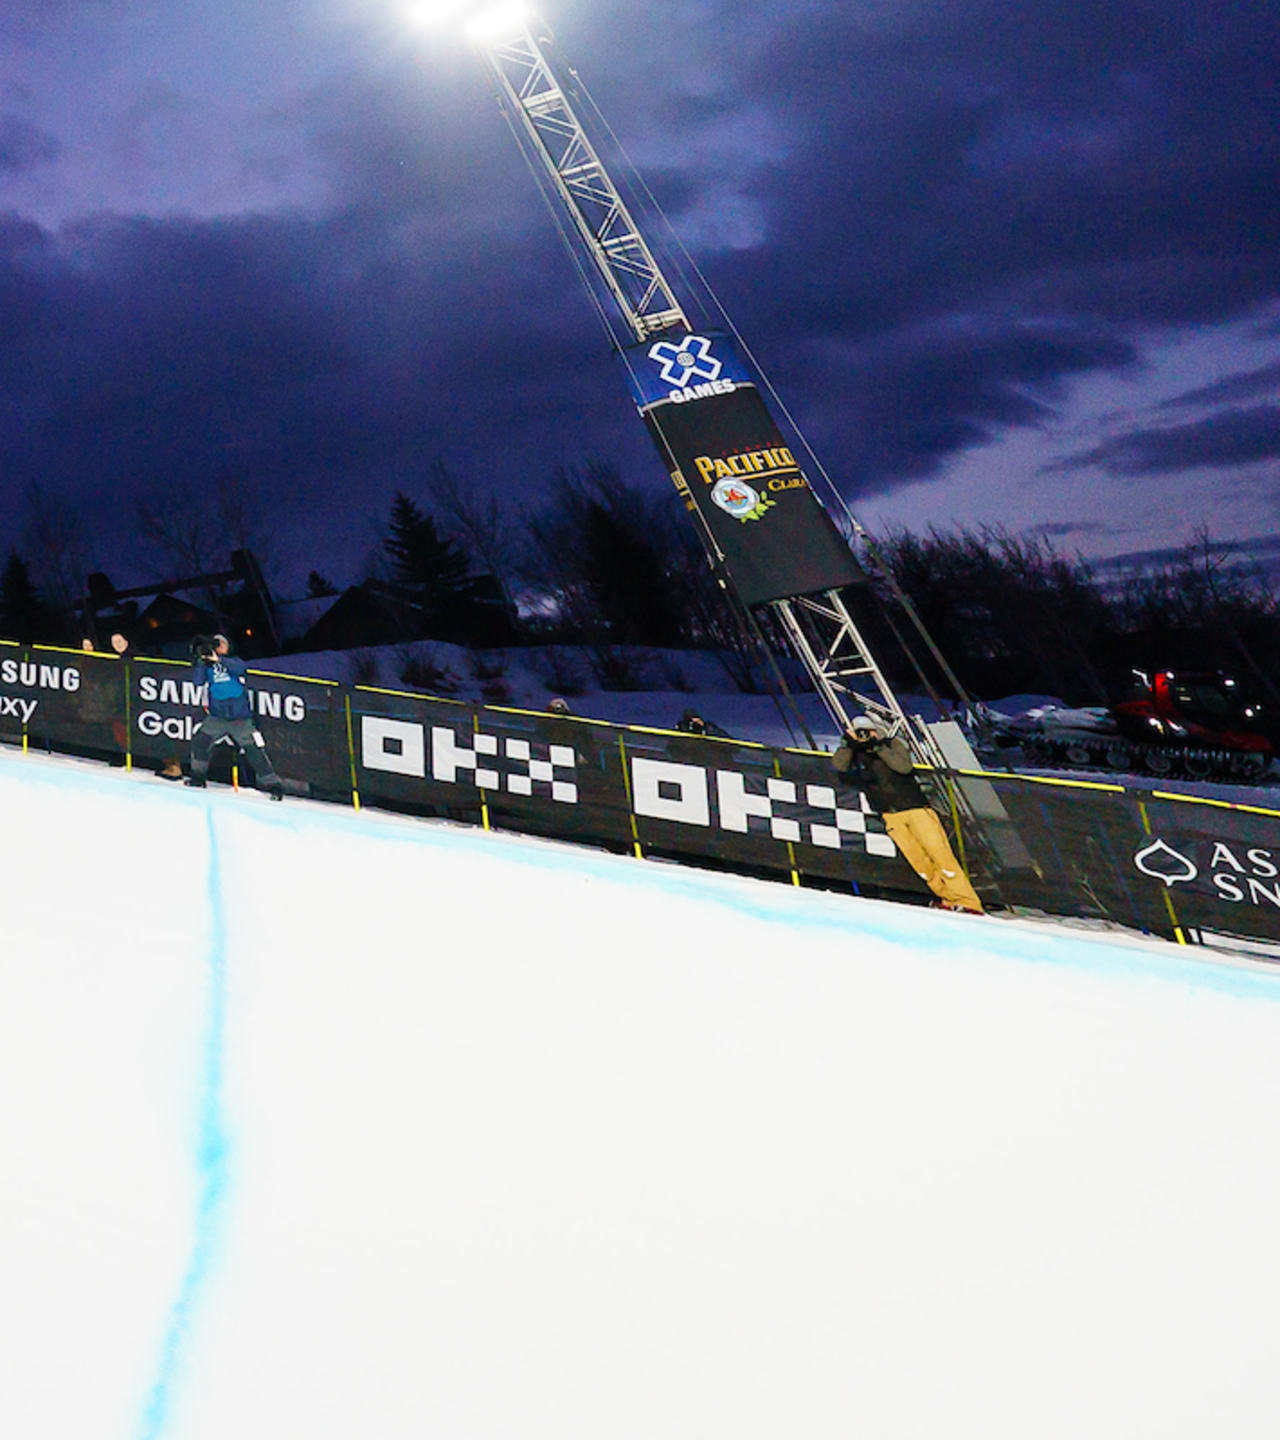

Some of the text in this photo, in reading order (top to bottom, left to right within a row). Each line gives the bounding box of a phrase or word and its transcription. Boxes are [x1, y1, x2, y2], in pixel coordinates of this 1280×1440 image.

[669, 378, 736, 404] GAMES
[694, 447, 796, 484] PACIFICO
[139, 676, 305, 722] SAMNG
[1210, 841, 1278, 878] AS
[1212, 872, 1280, 908] SN
